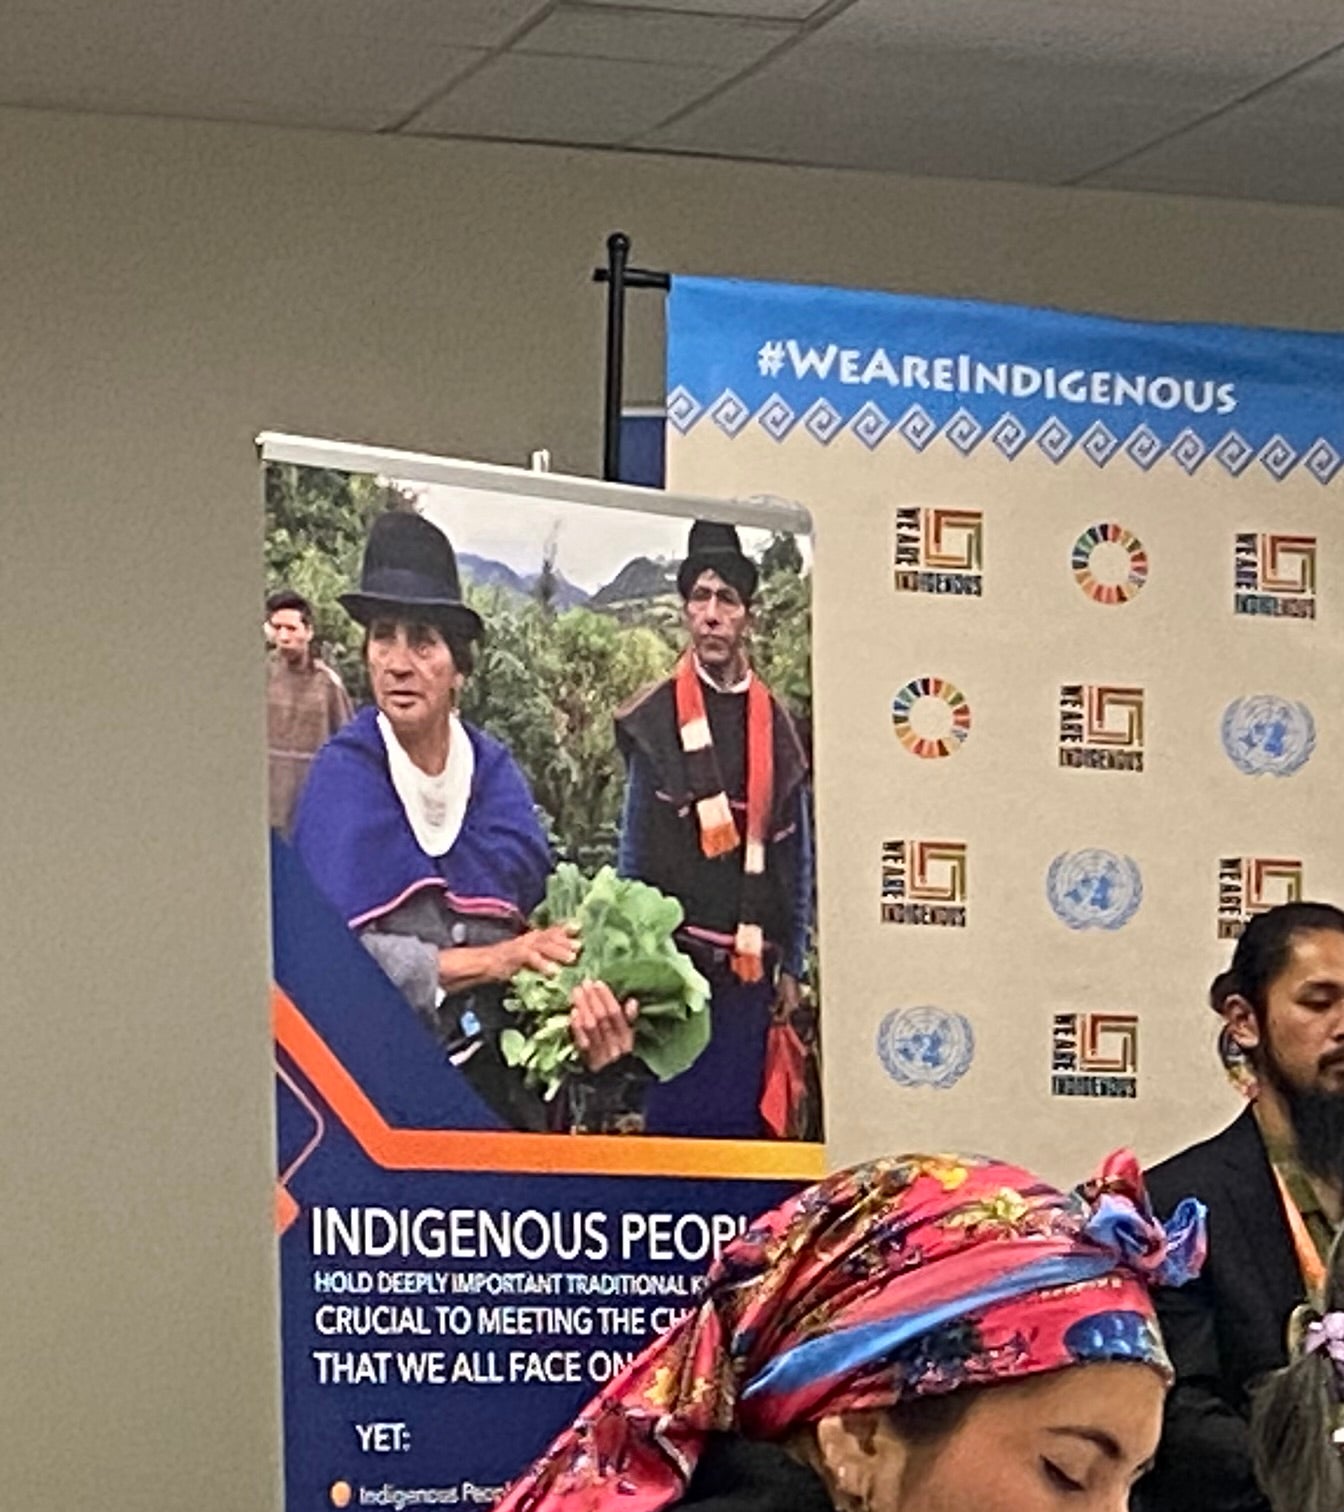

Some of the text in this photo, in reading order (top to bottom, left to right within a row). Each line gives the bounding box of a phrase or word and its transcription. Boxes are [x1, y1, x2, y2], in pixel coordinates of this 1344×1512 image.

[312, 1206, 608, 1261] INDIGENOUS
[314, 1270, 373, 1294] HOLD
[377, 1270, 448, 1294] DEEPLY
[452, 1272, 563, 1295] IMPORTANT
[565, 1273, 688, 1296] TRADITIONAL
[315, 1304, 432, 1335] CRUCIAL
[435, 1305, 472, 1335] TO
[477, 1306, 593, 1335] MEETING
[597, 1307, 646, 1335] THE
[313, 1352, 392, 1384] THAT
[396, 1352, 446, 1384] WE
[451, 1351, 504, 1384] ALL
[509, 1352, 582, 1382] FACE
[355, 1423, 411, 1452] YET:
